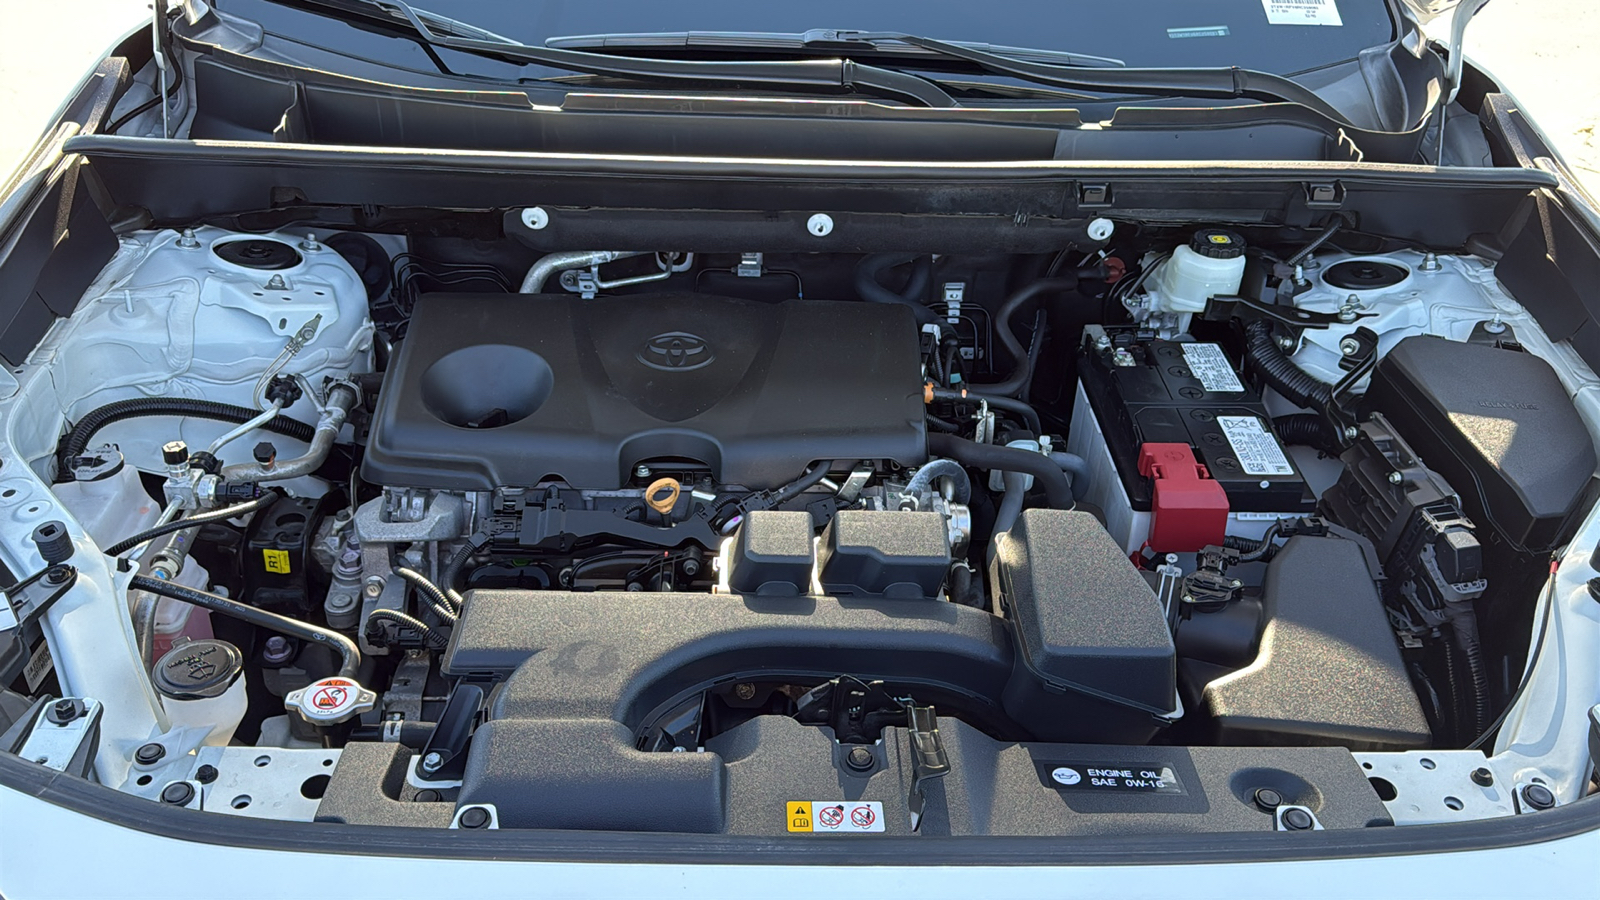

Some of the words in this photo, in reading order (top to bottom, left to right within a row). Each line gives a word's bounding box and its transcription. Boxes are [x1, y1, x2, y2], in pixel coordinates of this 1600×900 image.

[267, 555, 279, 569] R1
[1087, 768, 1133, 778] ENGINE
[1140, 770, 1162, 779] OIL
[1091, 778, 1118, 787] SAE
[1125, 779, 1165, 788] 0W-16
